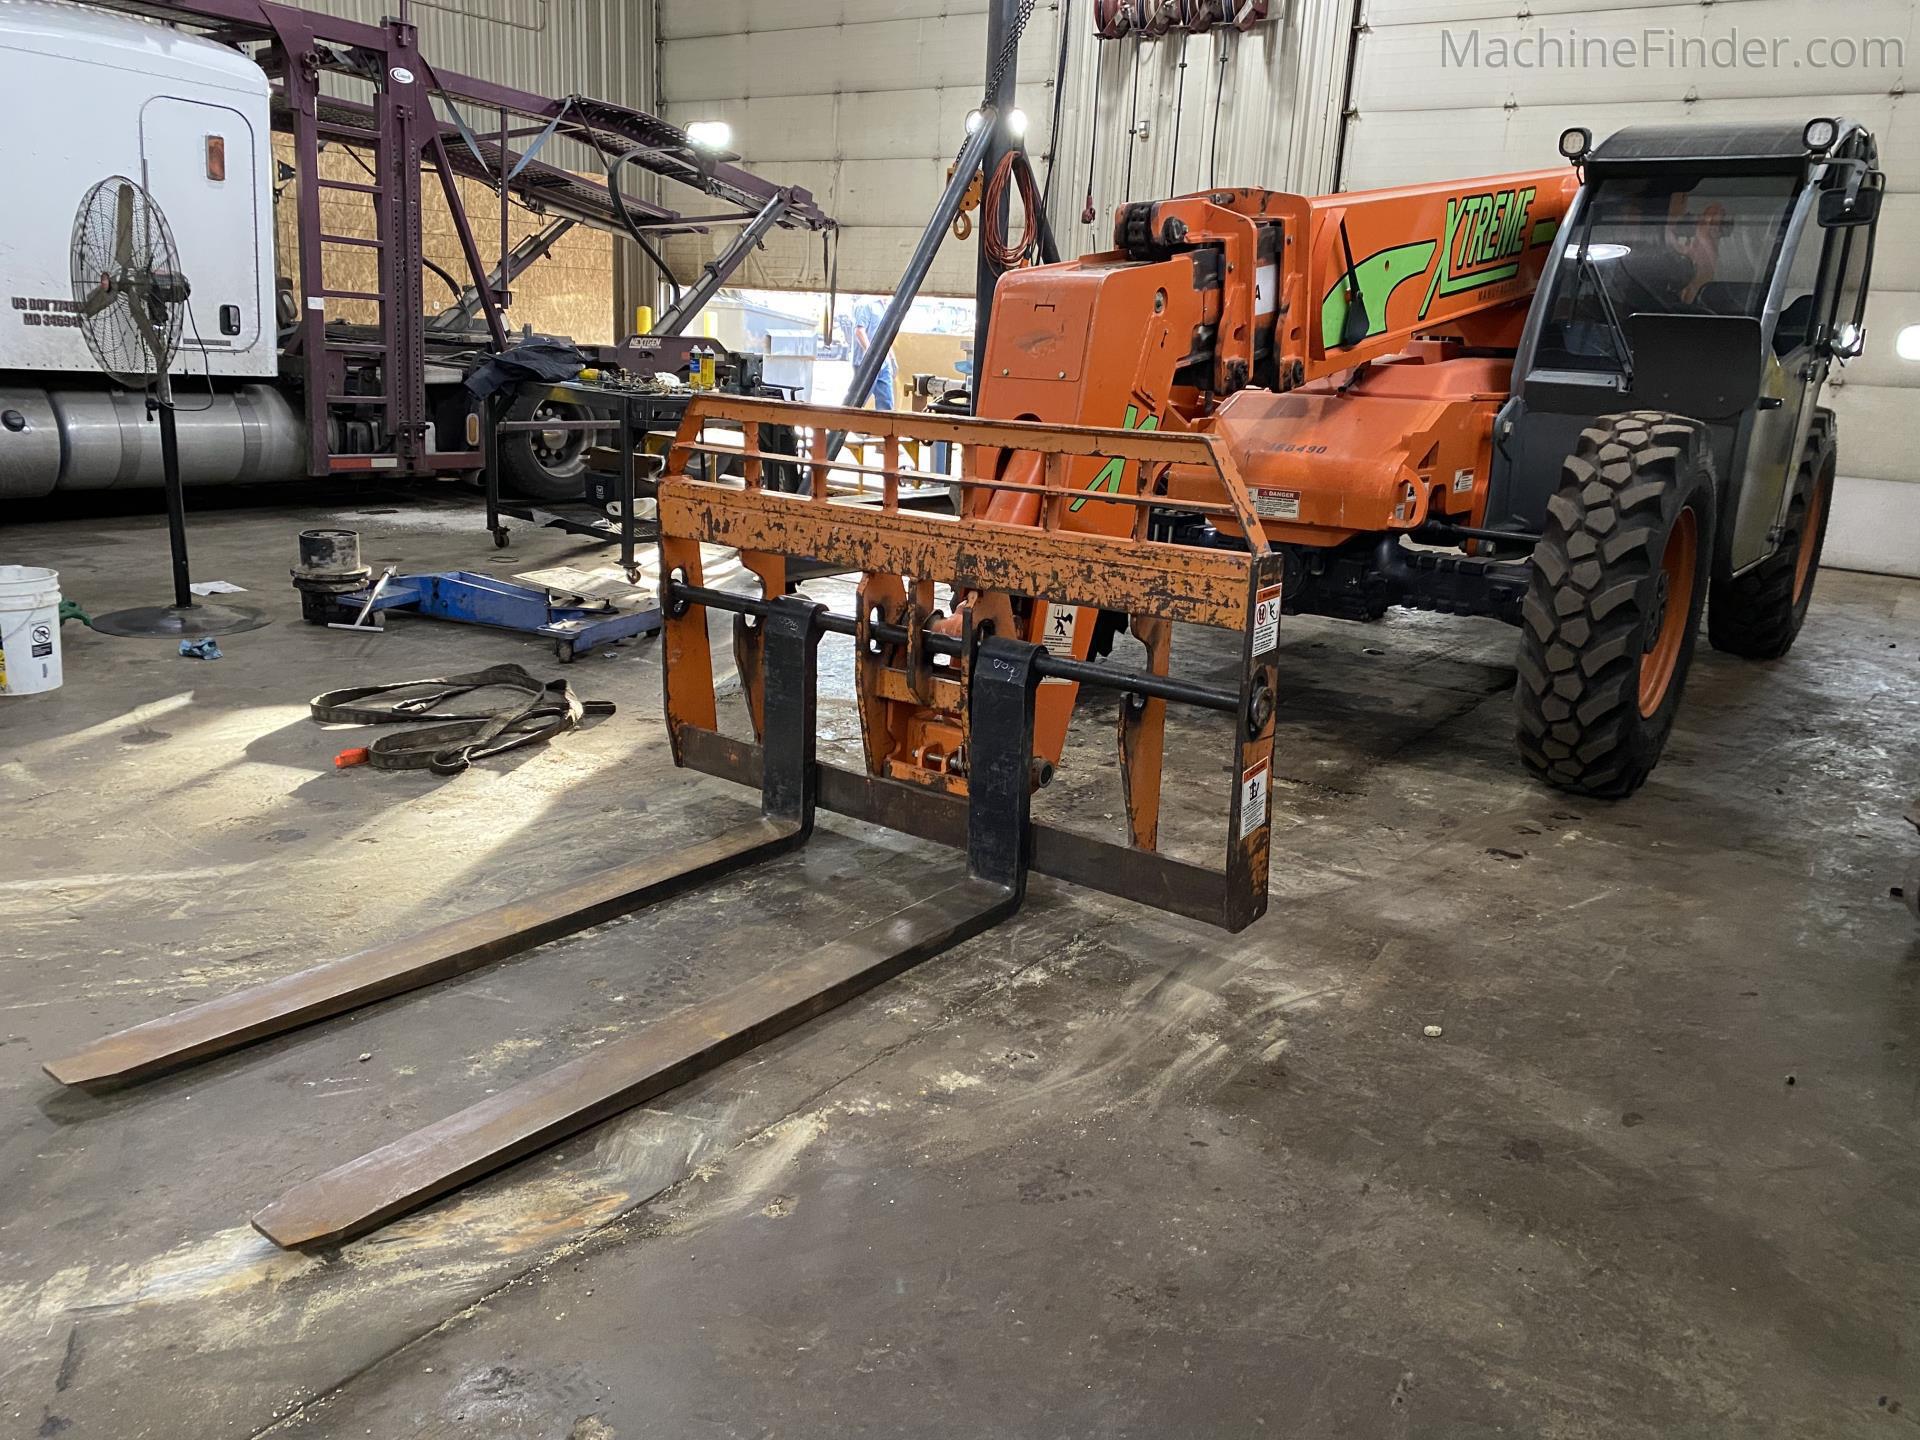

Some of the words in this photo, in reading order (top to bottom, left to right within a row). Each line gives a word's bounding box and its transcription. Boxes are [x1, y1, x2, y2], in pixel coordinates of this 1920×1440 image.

[1418, 186, 1536, 320] XTREME
[12, 297, 27, 309] US
[29, 298, 50, 311] DOT
[629, 338, 661, 348] NEXTGEN
[1268, 490, 1294, 498] DANGER
